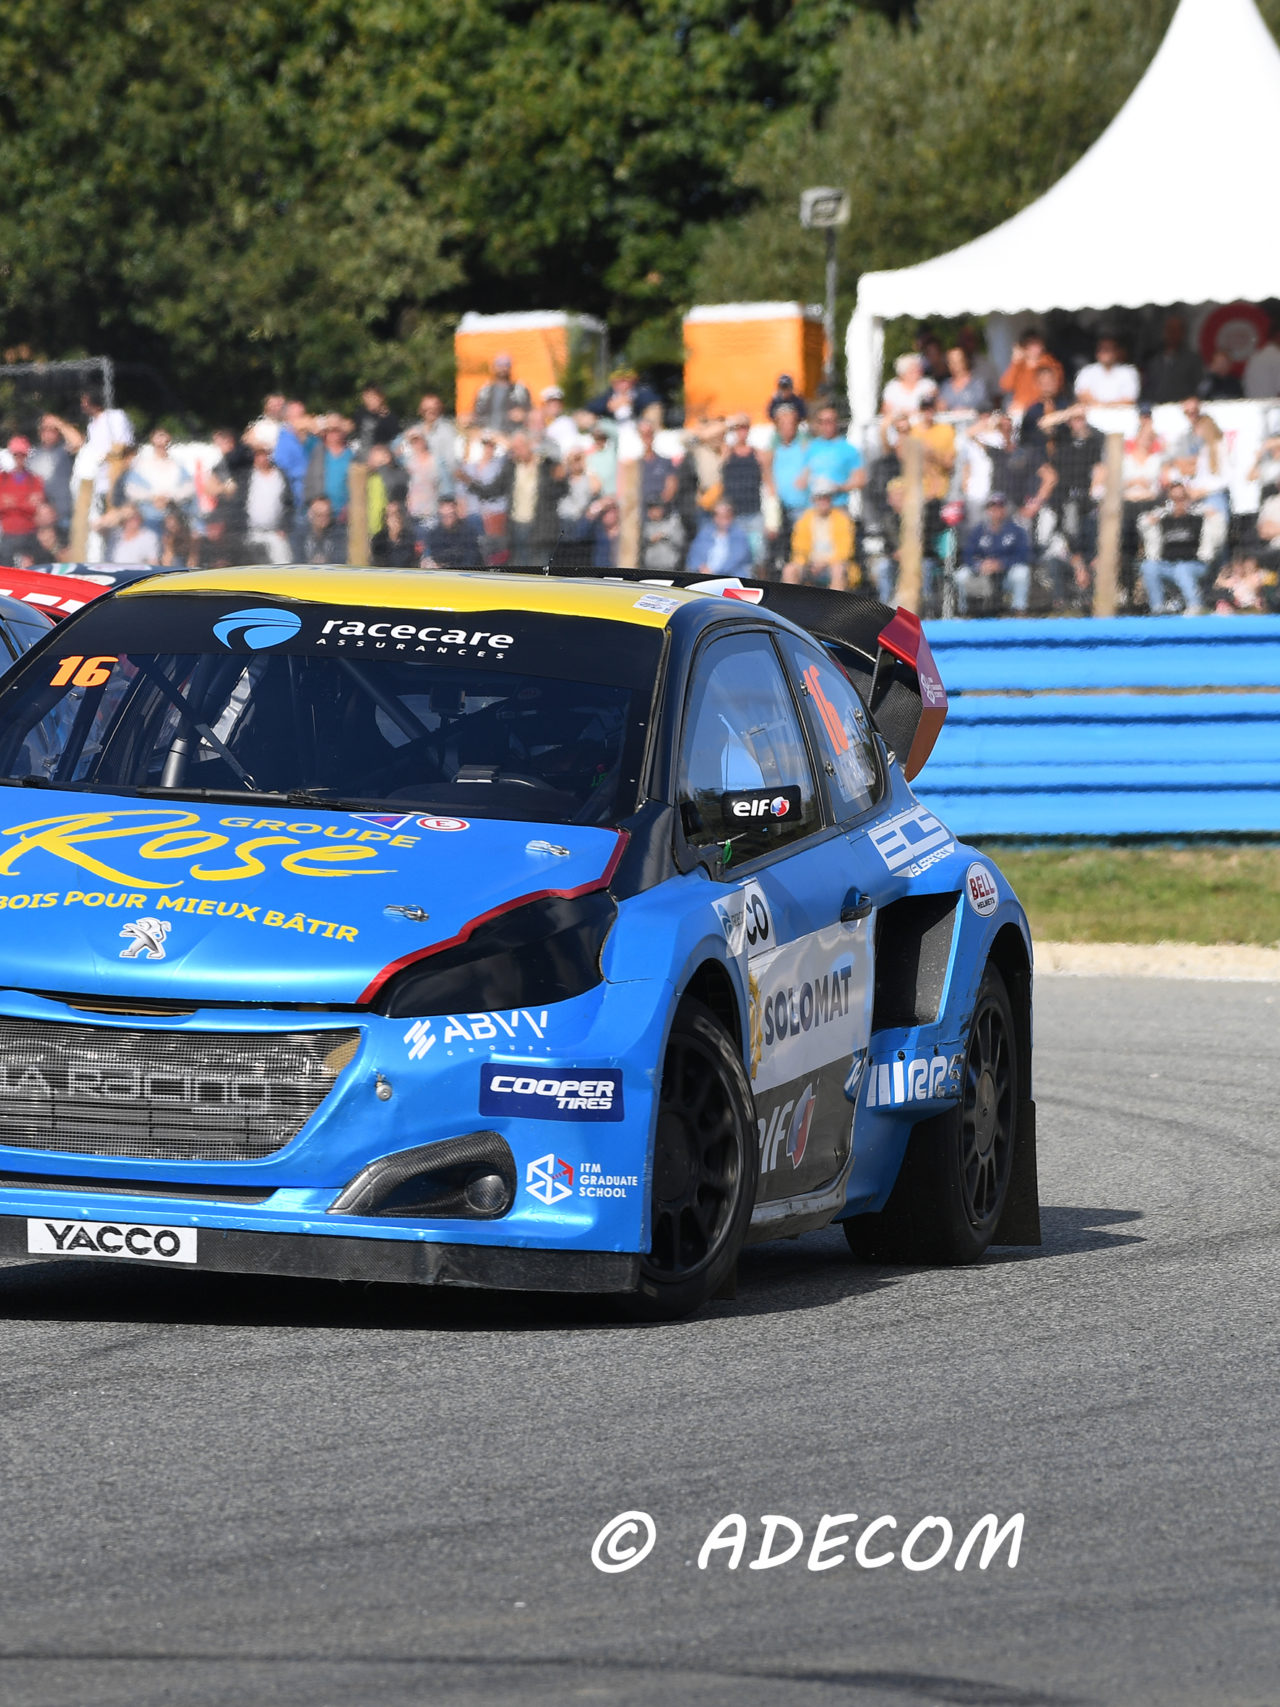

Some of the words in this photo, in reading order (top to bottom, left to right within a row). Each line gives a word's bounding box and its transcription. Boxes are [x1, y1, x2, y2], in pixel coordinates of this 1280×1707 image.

[316, 637, 505, 660] ASSURANCES
[321, 619, 515, 649] racecare
[49, 655, 120, 688] 16
[802, 664, 850, 757] 16
[732, 798, 771, 817] elf
[219, 816, 422, 849] GROUPE
[969, 872, 996, 901] BELL
[63, 890, 148, 910] POUR
[155, 896, 263, 923] MIEUX
[262, 909, 360, 943] BÂTIR
[764, 965, 852, 1046] SOLOMAT
[489, 1075, 615, 1098] COOPER
[555, 1097, 613, 1110] TIRES
[579, 1174, 639, 1187] GRADUATE
[580, 1162, 602, 1174] ITM
[578, 1186, 627, 1198] SCHOOL
[44, 1222, 181, 1257] YACCO
